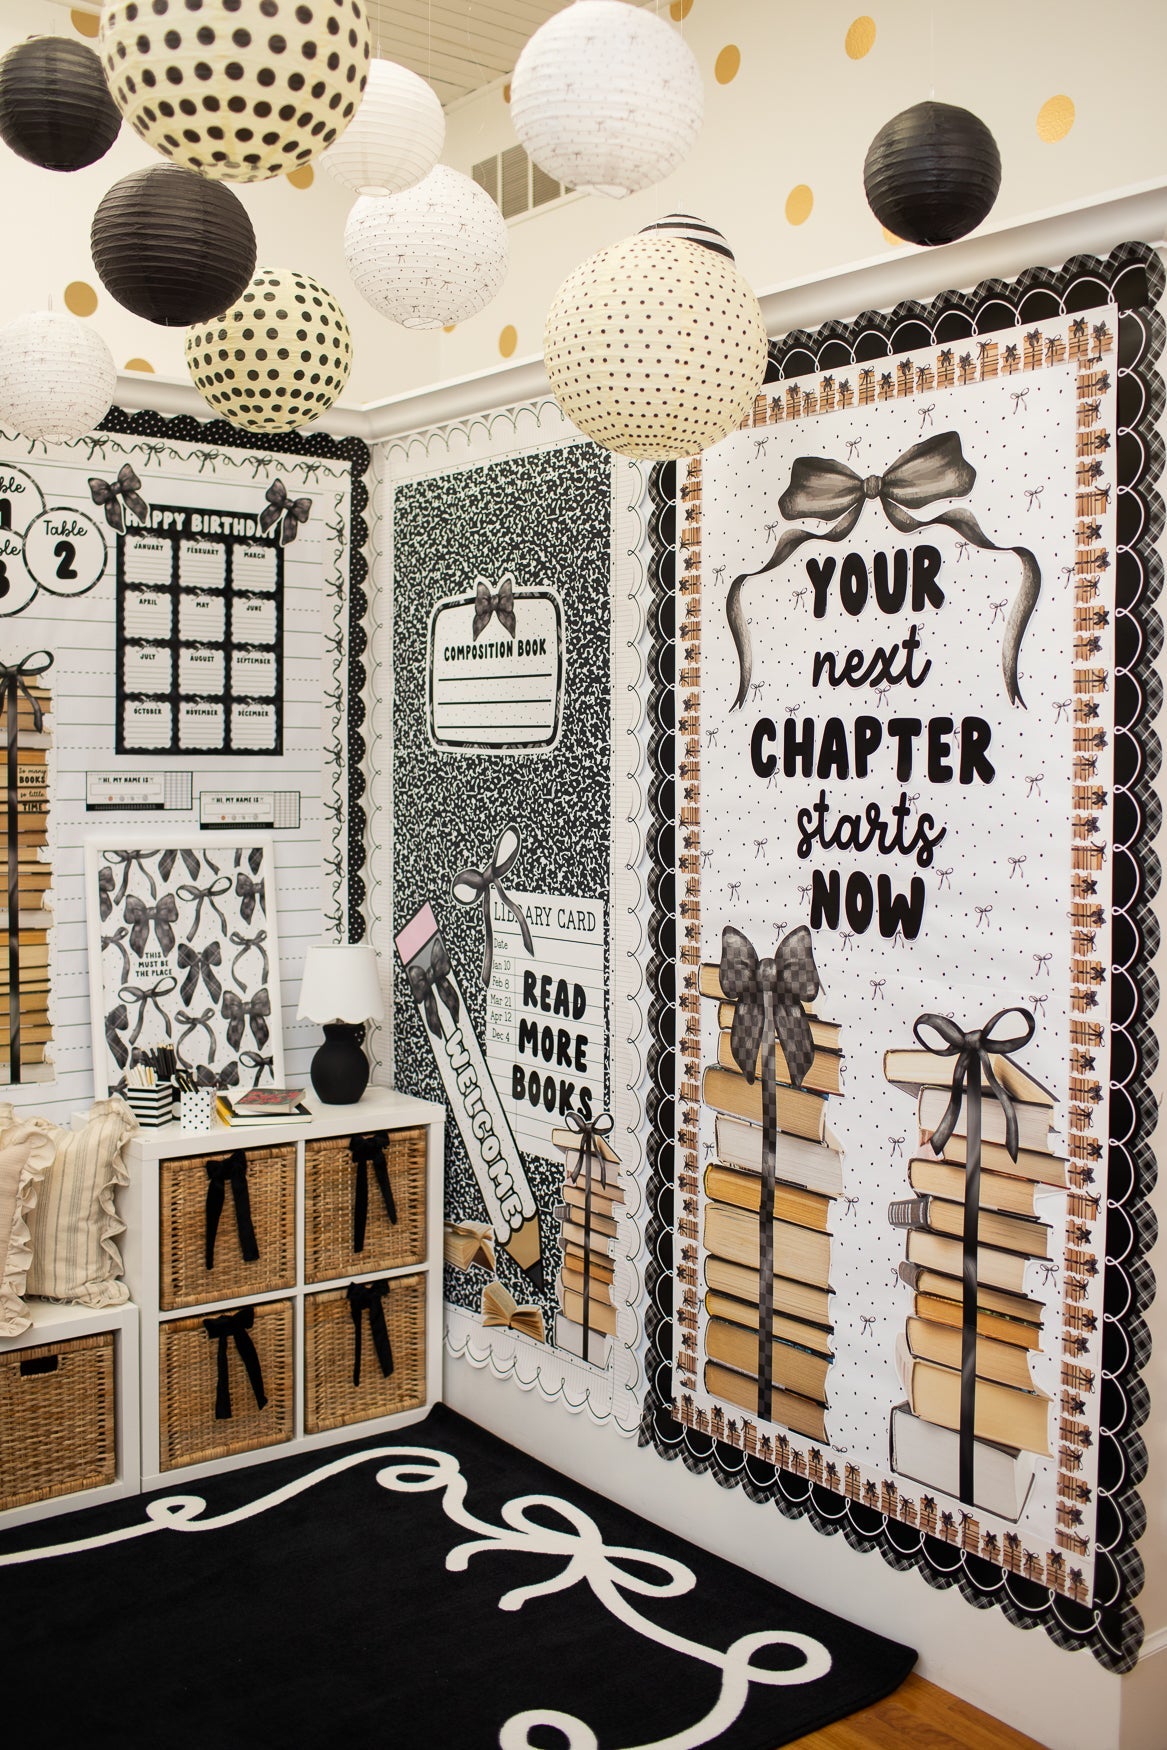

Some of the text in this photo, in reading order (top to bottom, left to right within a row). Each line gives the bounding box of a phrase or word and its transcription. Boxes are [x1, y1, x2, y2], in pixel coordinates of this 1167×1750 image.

[43, 520, 88, 537] Table
[133, 543, 164, 551] JANUARY
[186, 547, 219, 556] FEBRUARY
[53, 540, 78, 580] 2
[805, 544, 945, 619] YOUR
[444, 638, 547, 661] COMPOSITION BOOK
[811, 624, 932, 689] next
[190, 655, 215, 663] AUGUST
[236, 657, 271, 665] SEPTEMBER
[750, 715, 996, 785] CHAPTER
[19, 776, 45, 784] BOOKS
[22, 802, 43, 813] TIME
[796, 789, 948, 868] starts
[810, 869, 925, 942] NOW
[557, 908, 596, 932] CARD
[493, 937, 508, 950] Date
[503, 960, 511, 971] 10
[492, 976, 510, 990] Feb 8
[490, 994, 512, 1007] Mar 21
[523, 969, 587, 1020] READ
[490, 1010, 512, 1024] Apr 12
[492, 1028, 510, 1042] Dec 4
[518, 1018, 589, 1073] MORE
[512, 1064, 593, 1122] BOOKS
[445, 1027, 524, 1223] WELCOME
